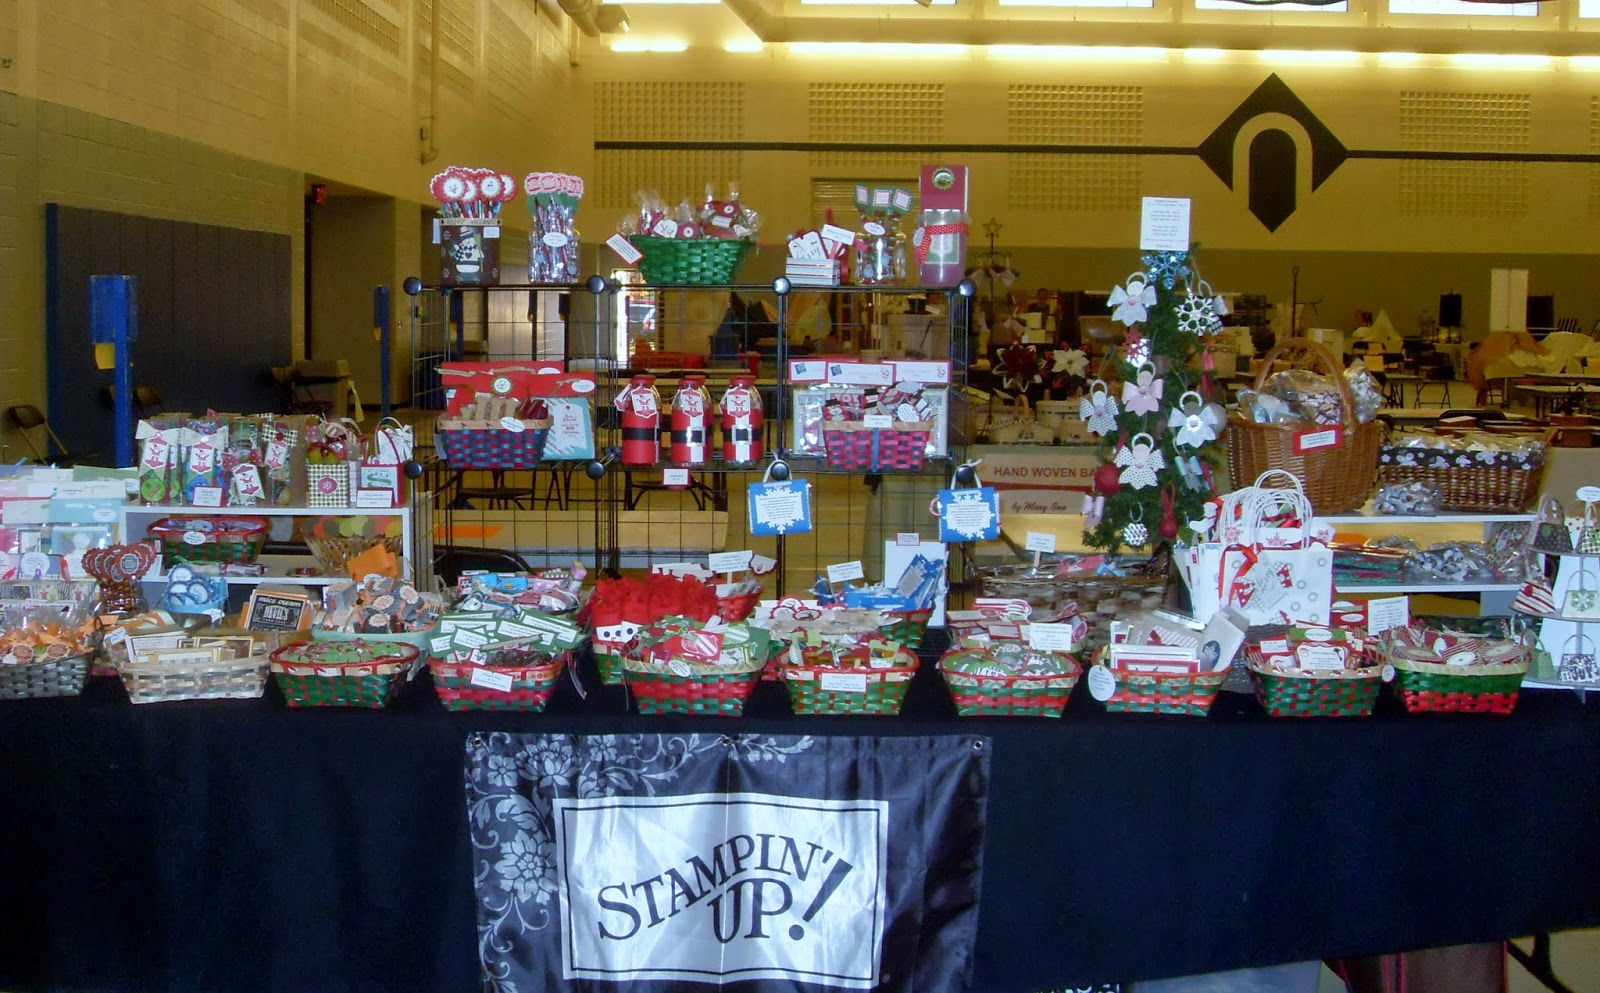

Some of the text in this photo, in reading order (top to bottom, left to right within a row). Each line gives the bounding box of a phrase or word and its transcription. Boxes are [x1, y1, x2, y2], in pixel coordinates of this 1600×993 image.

[994, 467, 1028, 477] HAND
[1032, 467, 1077, 477] WOVEN
[1012, 502, 1021, 513] by
[1023, 501, 1048, 513] Mary
[597, 833, 834, 940] STAMPIN'
[707, 858, 853, 943] UP!
